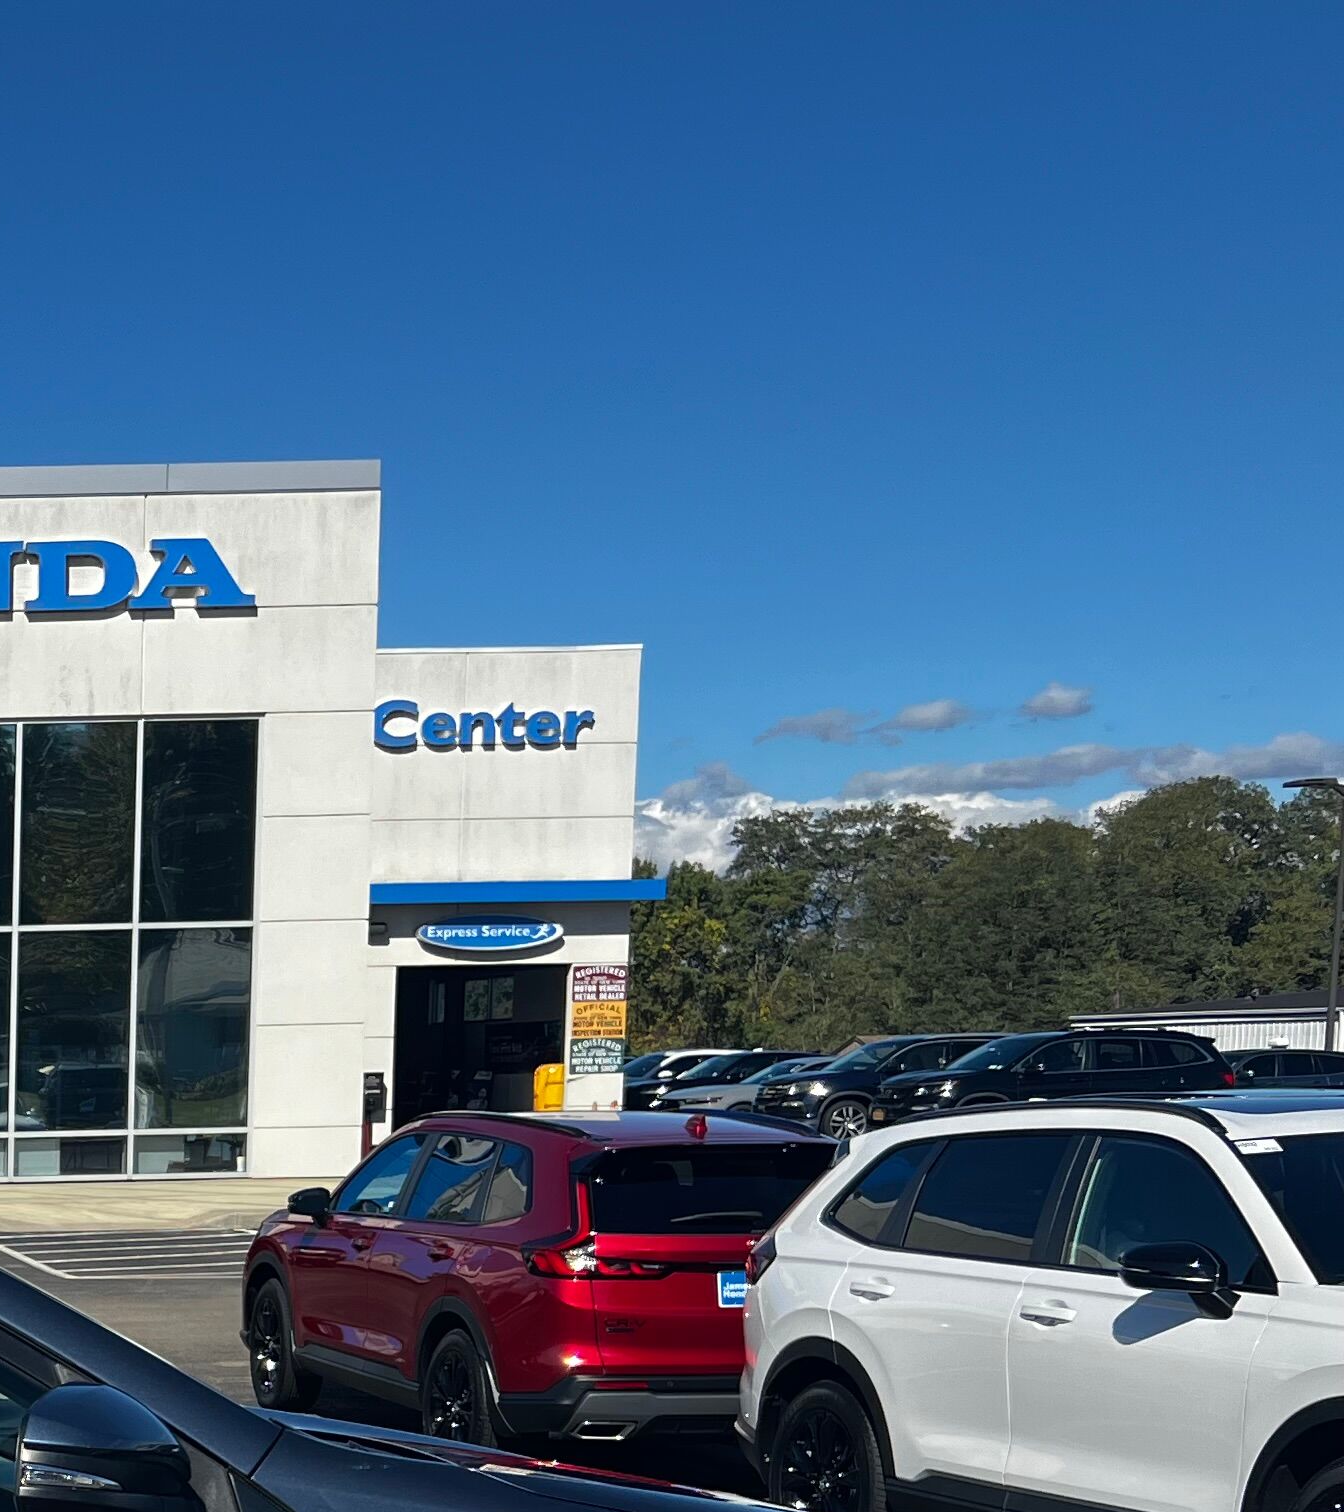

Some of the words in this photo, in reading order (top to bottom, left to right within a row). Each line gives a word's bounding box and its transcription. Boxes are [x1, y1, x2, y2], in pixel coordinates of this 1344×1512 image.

[374, 700, 593, 749] Center
[427, 926, 478, 941] Express
[481, 925, 531, 937] Service
[575, 965, 626, 979] REGISTERED
[573, 984, 597, 993] MOTOR
[598, 984, 625, 992] VEHICLE
[599, 992, 625, 1000] DEALER
[575, 1003, 622, 1015] OFFICIAL
[572, 1039, 621, 1052] REGISTERED
[571, 1057, 593, 1065] MOTOR
[594, 1056, 621, 1065] VEHICLE
[575, 1065, 599, 1073] REPAIR
[600, 1064, 618, 1072] SHOP
